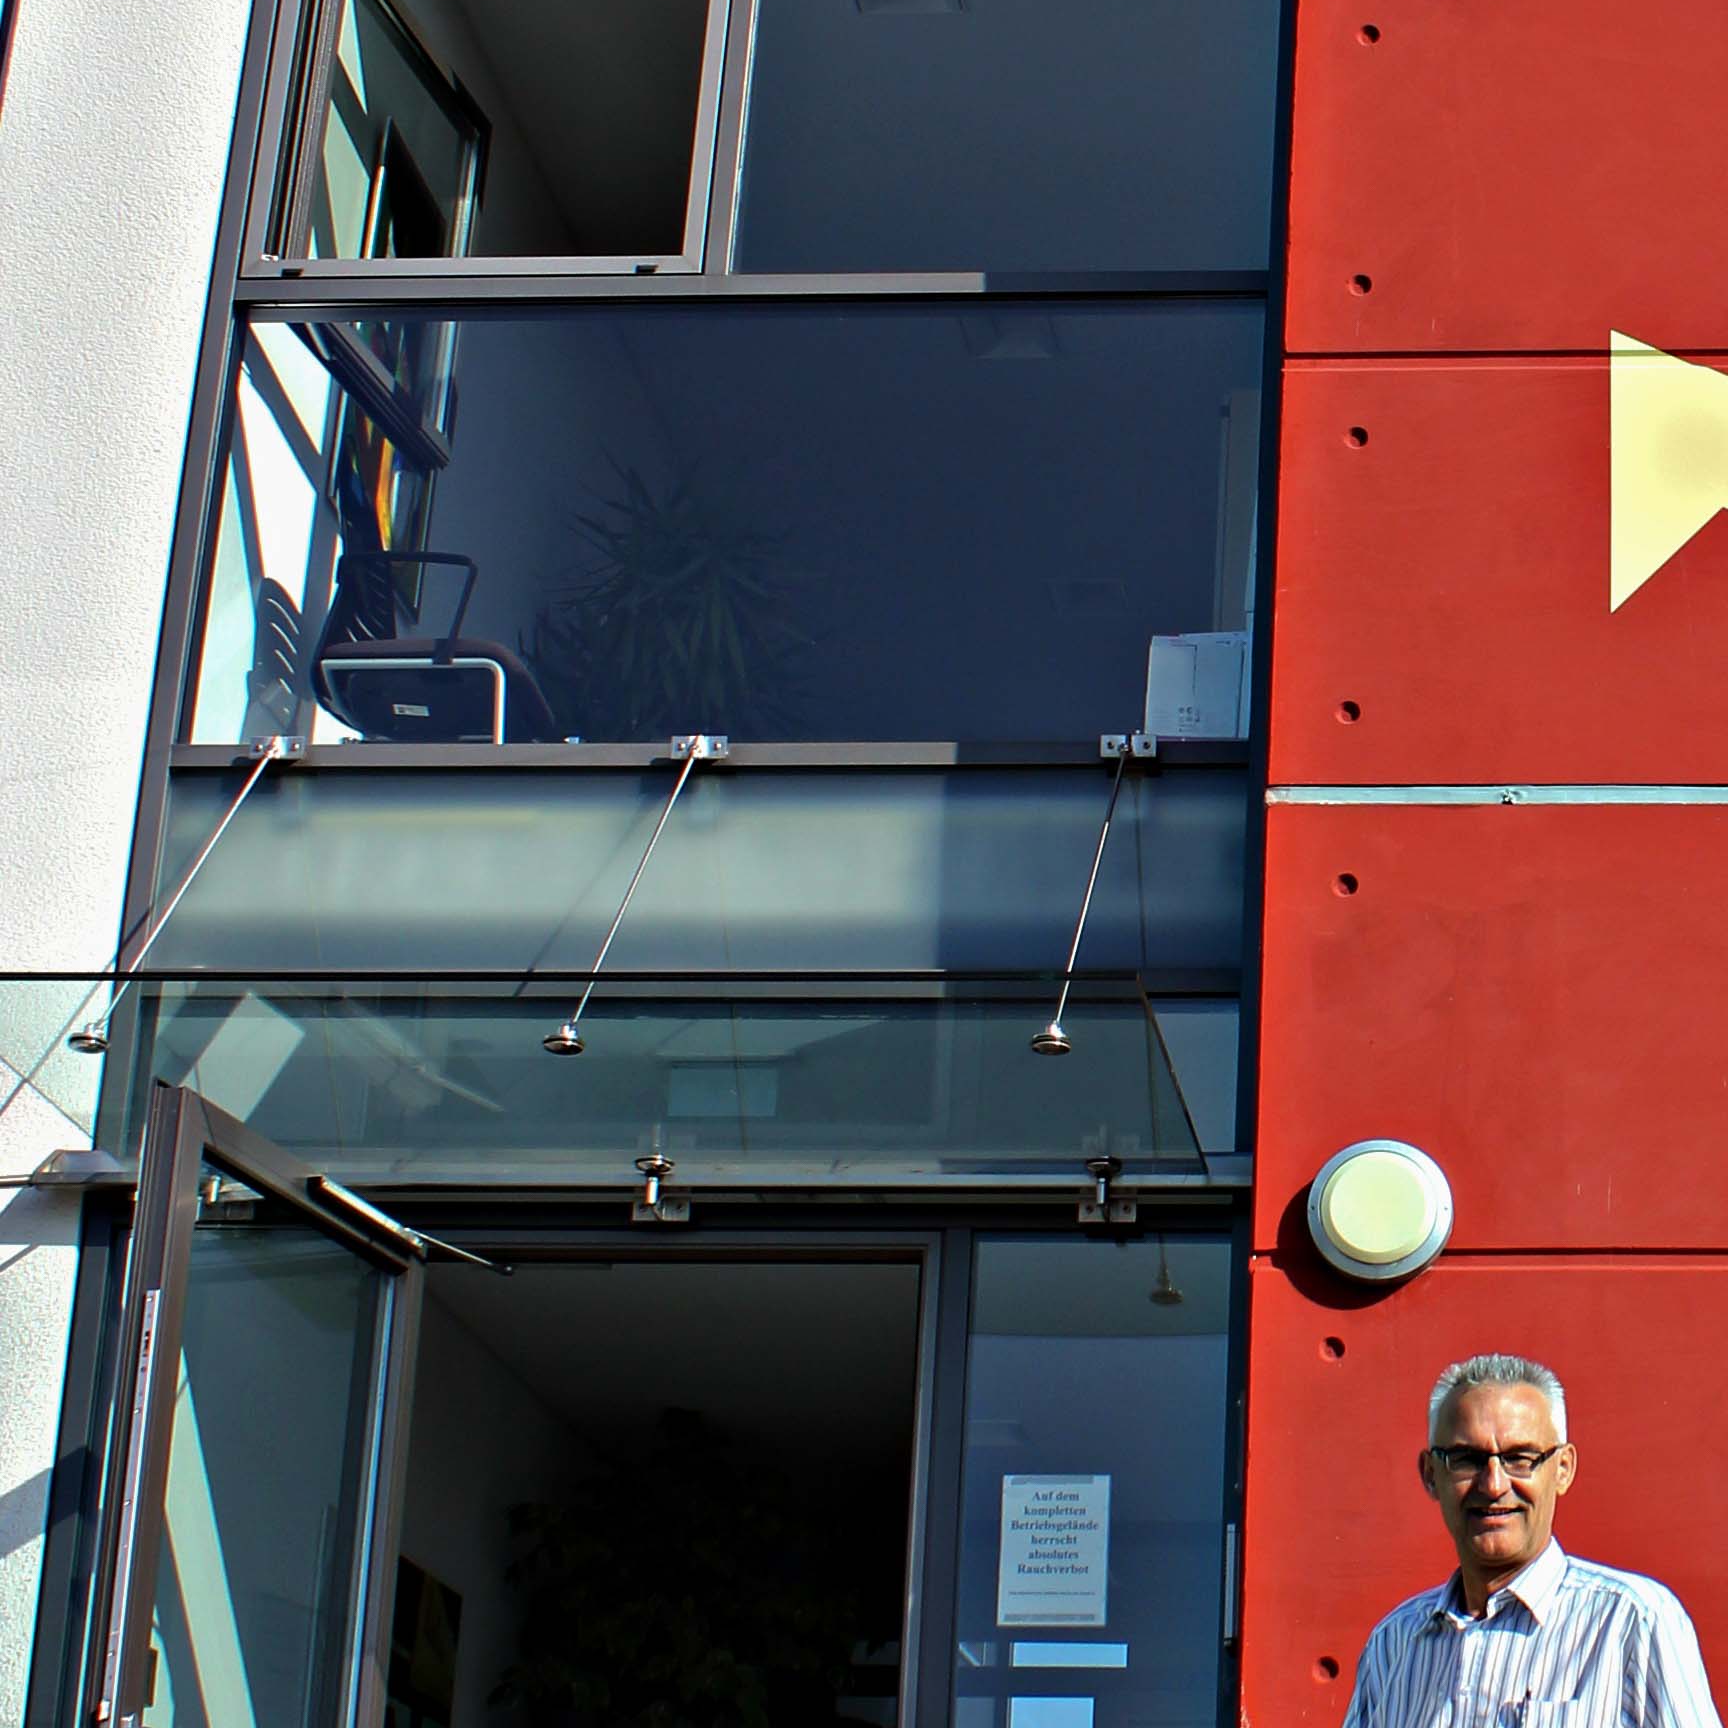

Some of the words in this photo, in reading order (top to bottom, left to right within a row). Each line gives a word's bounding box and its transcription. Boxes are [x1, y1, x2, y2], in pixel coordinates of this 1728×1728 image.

[1032, 1491, 1053, 1502] Auf
[1056, 1491, 1080, 1502] dem
[1024, 1506, 1086, 1518] kompletten
[1011, 1520, 1099, 1532] Betriebsgelände
[1031, 1535, 1077, 1546] herrscht
[1028, 1549, 1079, 1560] absolutes
[1017, 1563, 1089, 1574] Rauchverbot
